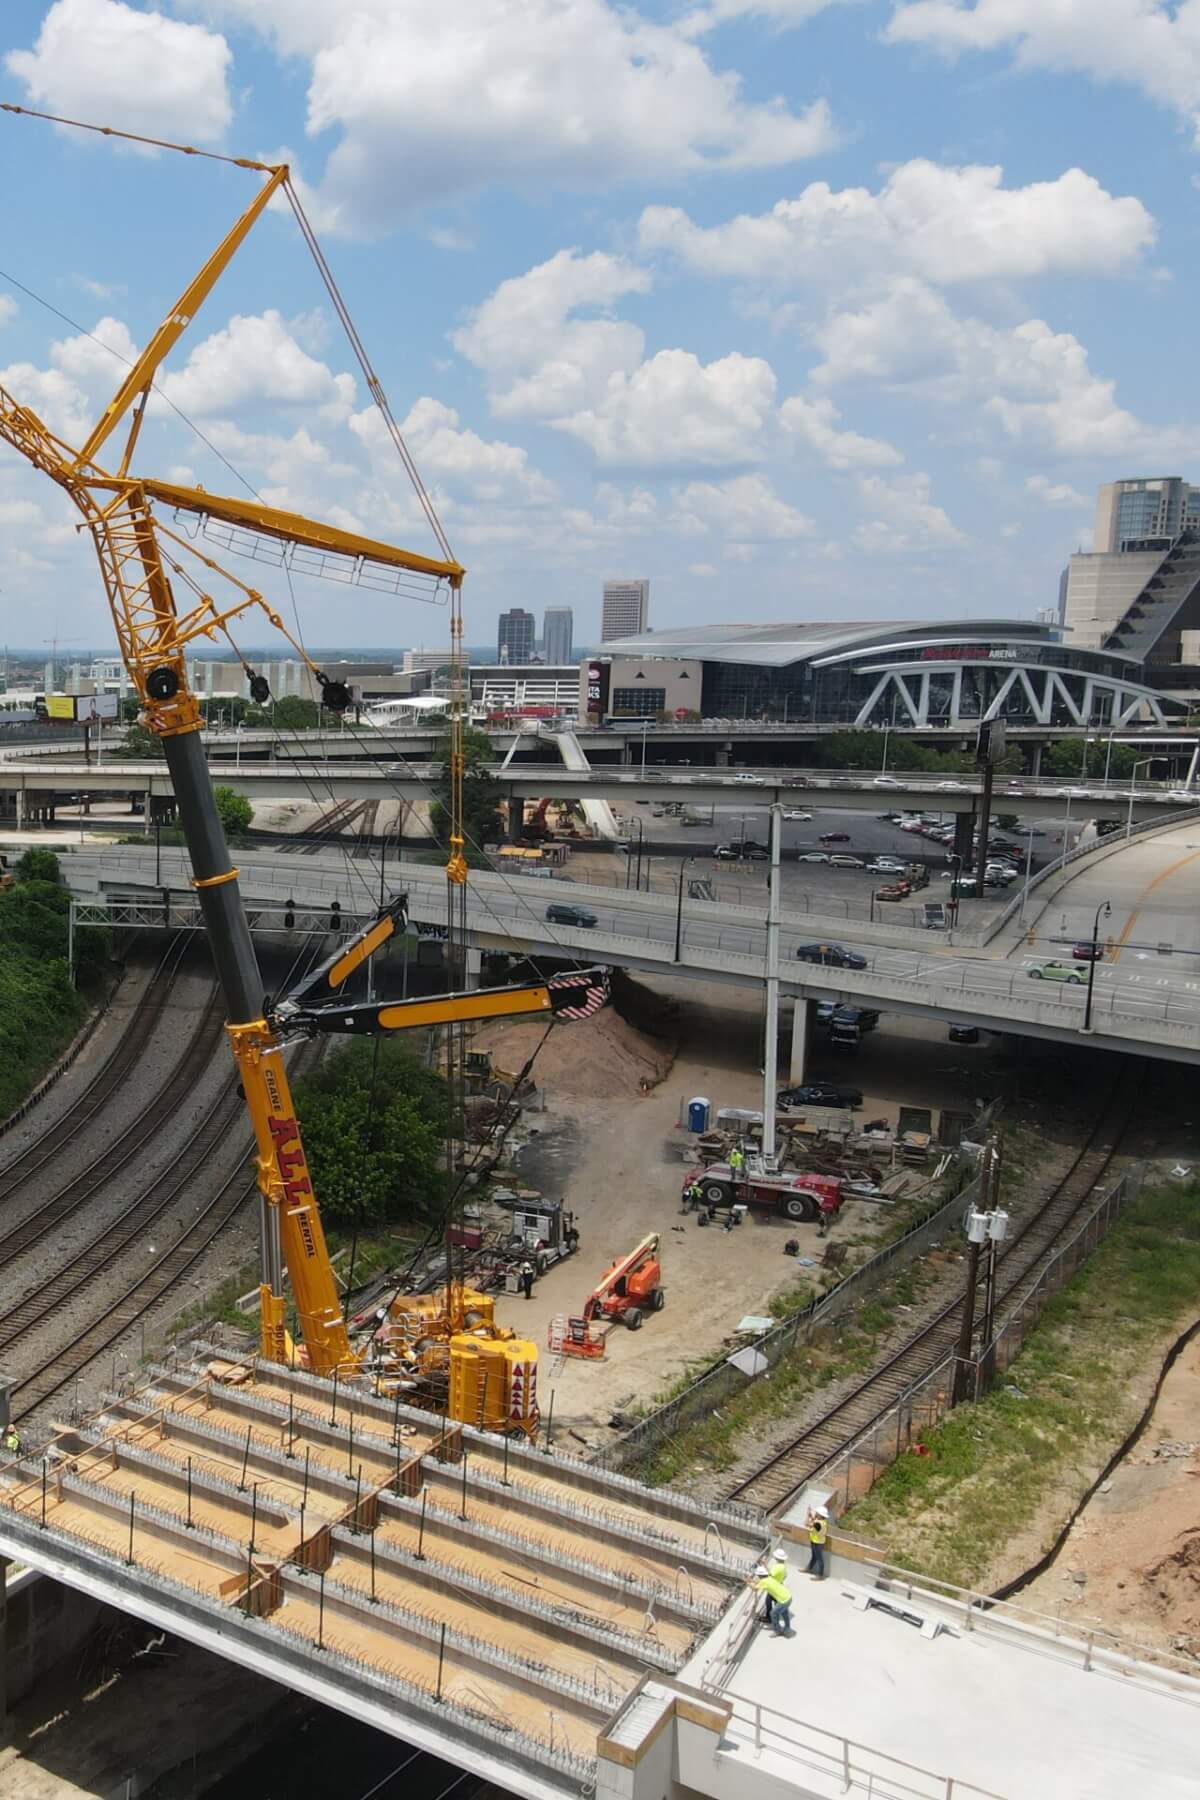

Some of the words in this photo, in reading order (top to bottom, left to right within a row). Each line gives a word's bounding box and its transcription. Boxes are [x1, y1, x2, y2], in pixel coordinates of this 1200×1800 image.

[988, 648, 1017, 658] ARENA
[264, 1069, 283, 1113] CRANE
[268, 1114, 311, 1206] ALL
[299, 1212, 315, 1257] RENTAL
